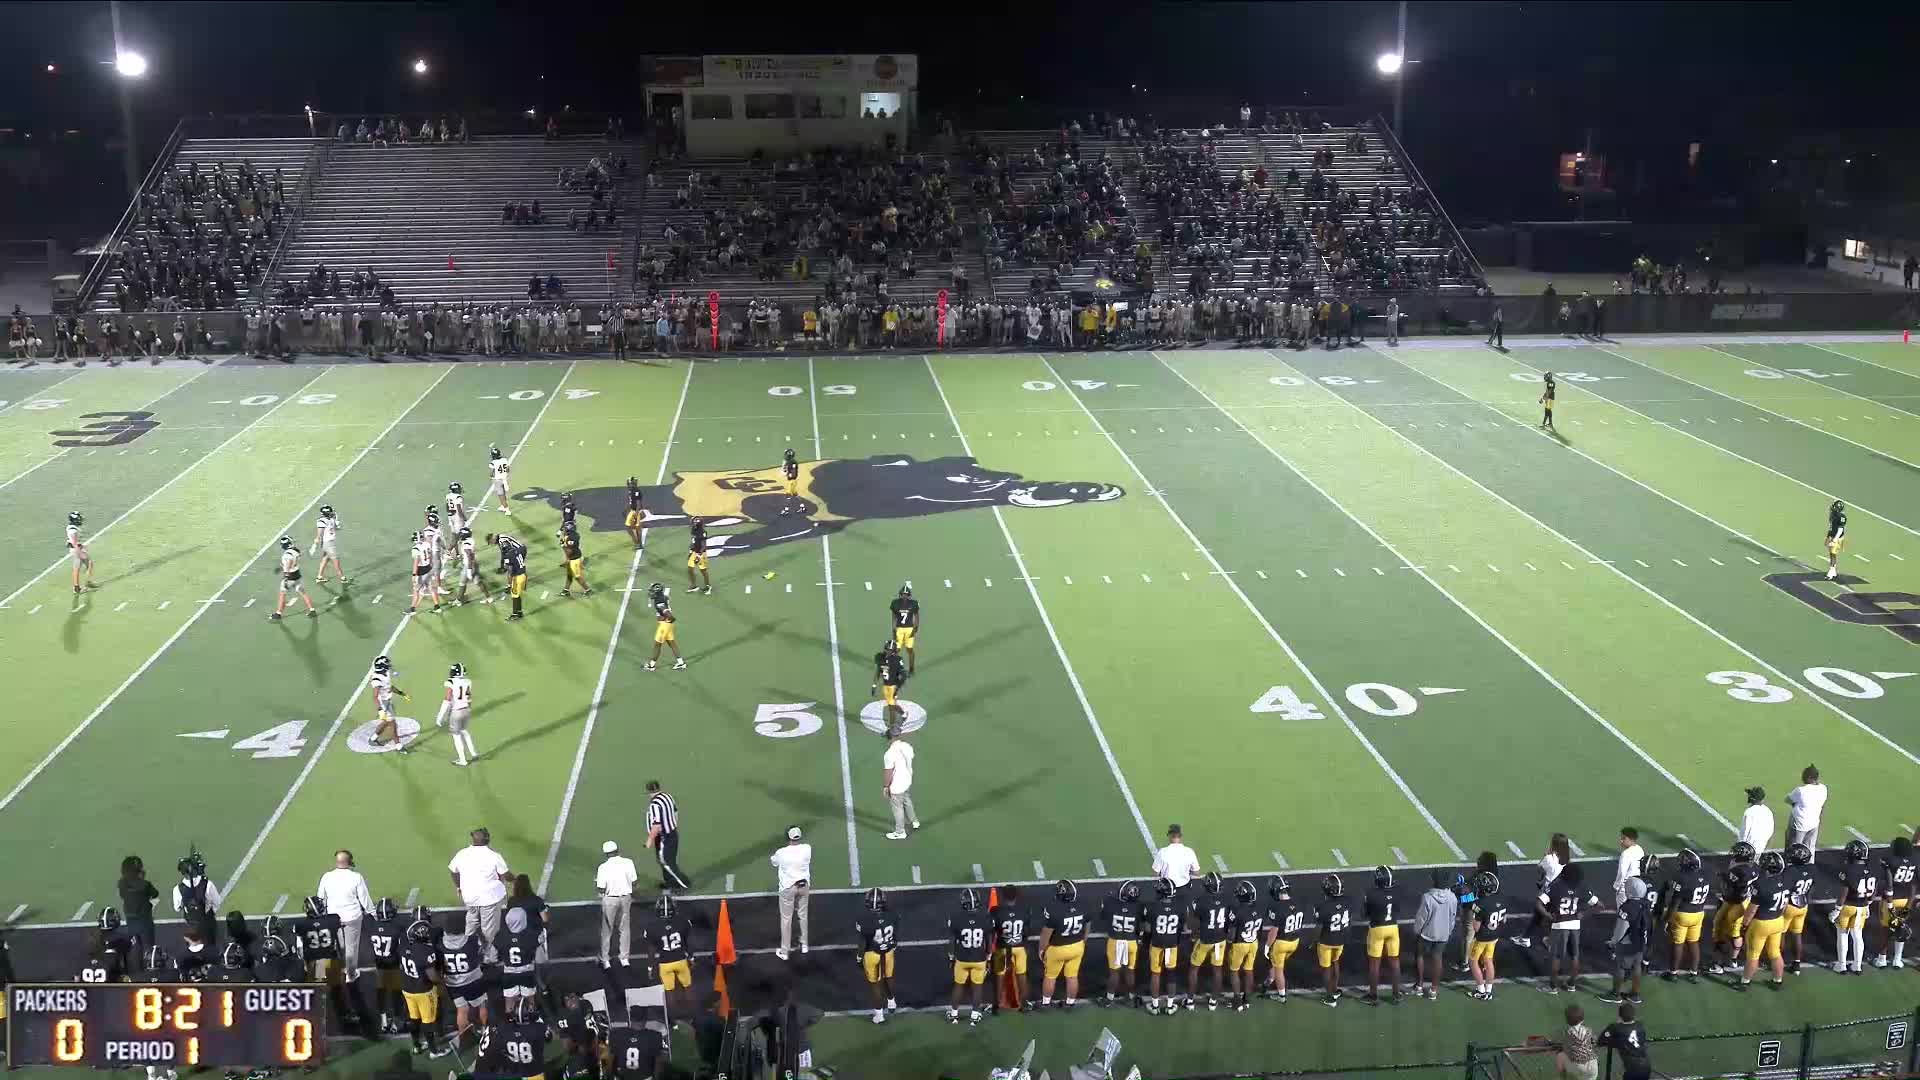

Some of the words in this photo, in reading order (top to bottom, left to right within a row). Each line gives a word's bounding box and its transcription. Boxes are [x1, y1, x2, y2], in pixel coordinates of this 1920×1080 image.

[1704, 666, 1885, 704] 30
[1249, 681, 1419, 722] 40
[753, 699, 928, 739] 50
[232, 716, 421, 760] 40
[1857, 876, 1877, 898] 49
[1112, 914, 1136, 933] 55
[1208, 907, 1226, 929] 14
[1284, 911, 1304, 934] 80
[1329, 909, 1350, 932] 24
[1384, 903, 1393, 922] 1
[1060, 914, 1084, 937] 75
[1155, 914, 1179, 935] 82
[306, 929, 332, 950] 33
[370, 936, 392, 957] 27
[660, 931, 682, 952] 12
[961, 928, 984, 949] 38
[445, 953, 470, 974] 56
[508, 946, 523, 965] 6
[1628, 1030, 1640, 1049] 4
[506, 1041, 533, 1064] 98
[625, 1047, 640, 1070] 8
